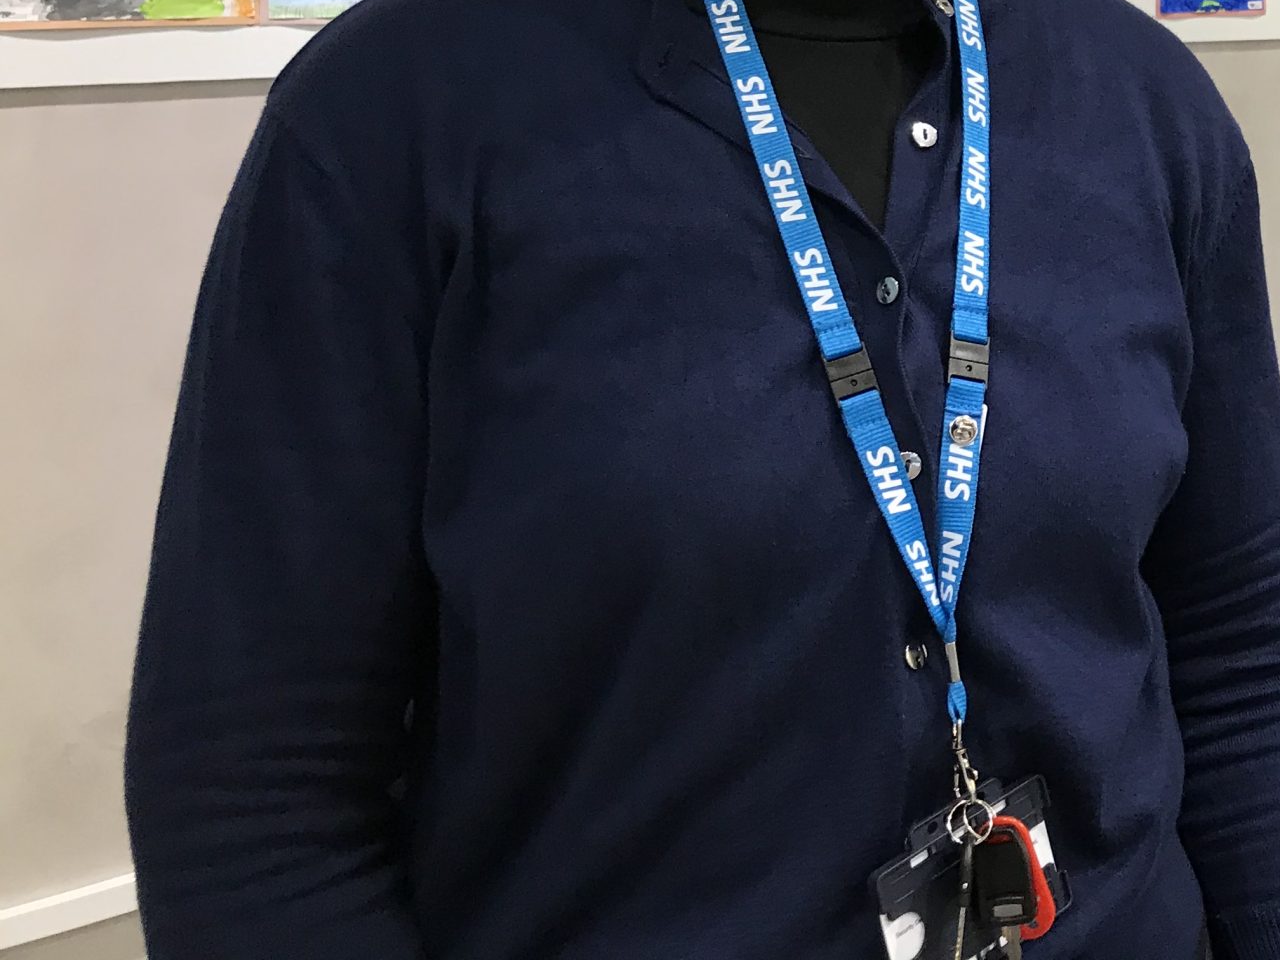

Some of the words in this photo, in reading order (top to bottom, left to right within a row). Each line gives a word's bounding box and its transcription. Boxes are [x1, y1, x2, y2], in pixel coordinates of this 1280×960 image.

[711, 0, 750, 54] NHS
[737, 76, 778, 136] NHS
[966, 67, 986, 127] NHS
[764, 159, 807, 223] NHS
[965, 146, 986, 210] NHS
[794, 247, 838, 312] NHS
[961, 231, 985, 297] NHS
[866, 445, 912, 515] NHS
[940, 531, 963, 603] NHS
